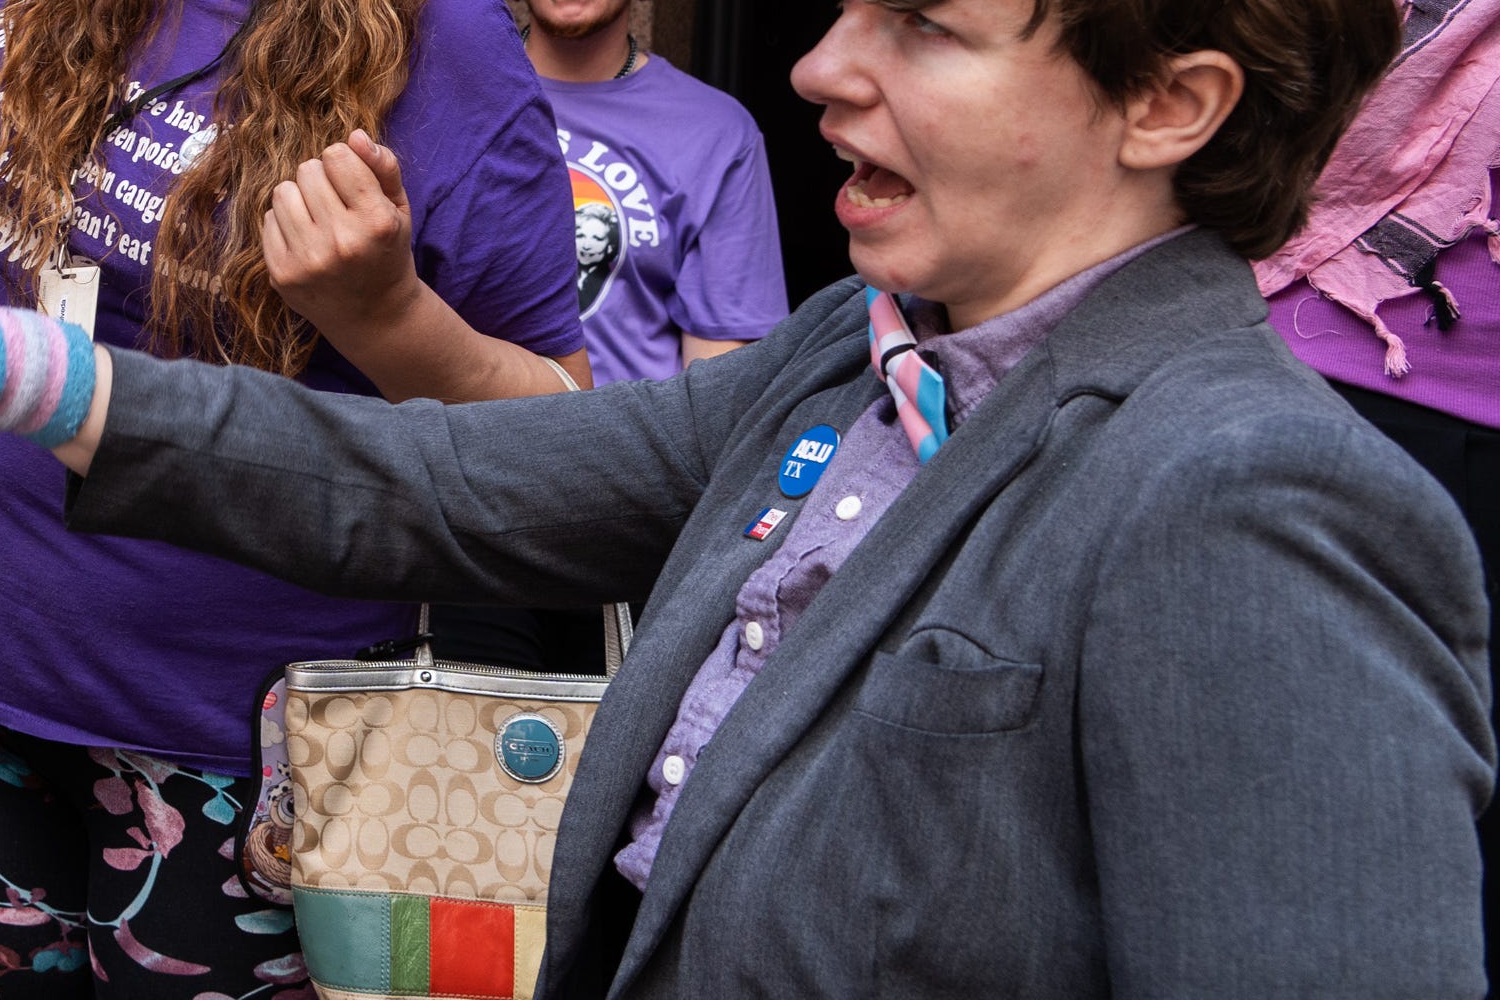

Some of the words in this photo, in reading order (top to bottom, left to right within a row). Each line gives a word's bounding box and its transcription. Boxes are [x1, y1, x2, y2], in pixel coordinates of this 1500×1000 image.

[164, 100, 206, 134] has
[578, 141, 660, 248] LOVE
[71, 205, 117, 247] can't
[118, 233, 152, 266] eat
[792, 439, 834, 464] ACLU
[784, 460, 806, 479] TX
